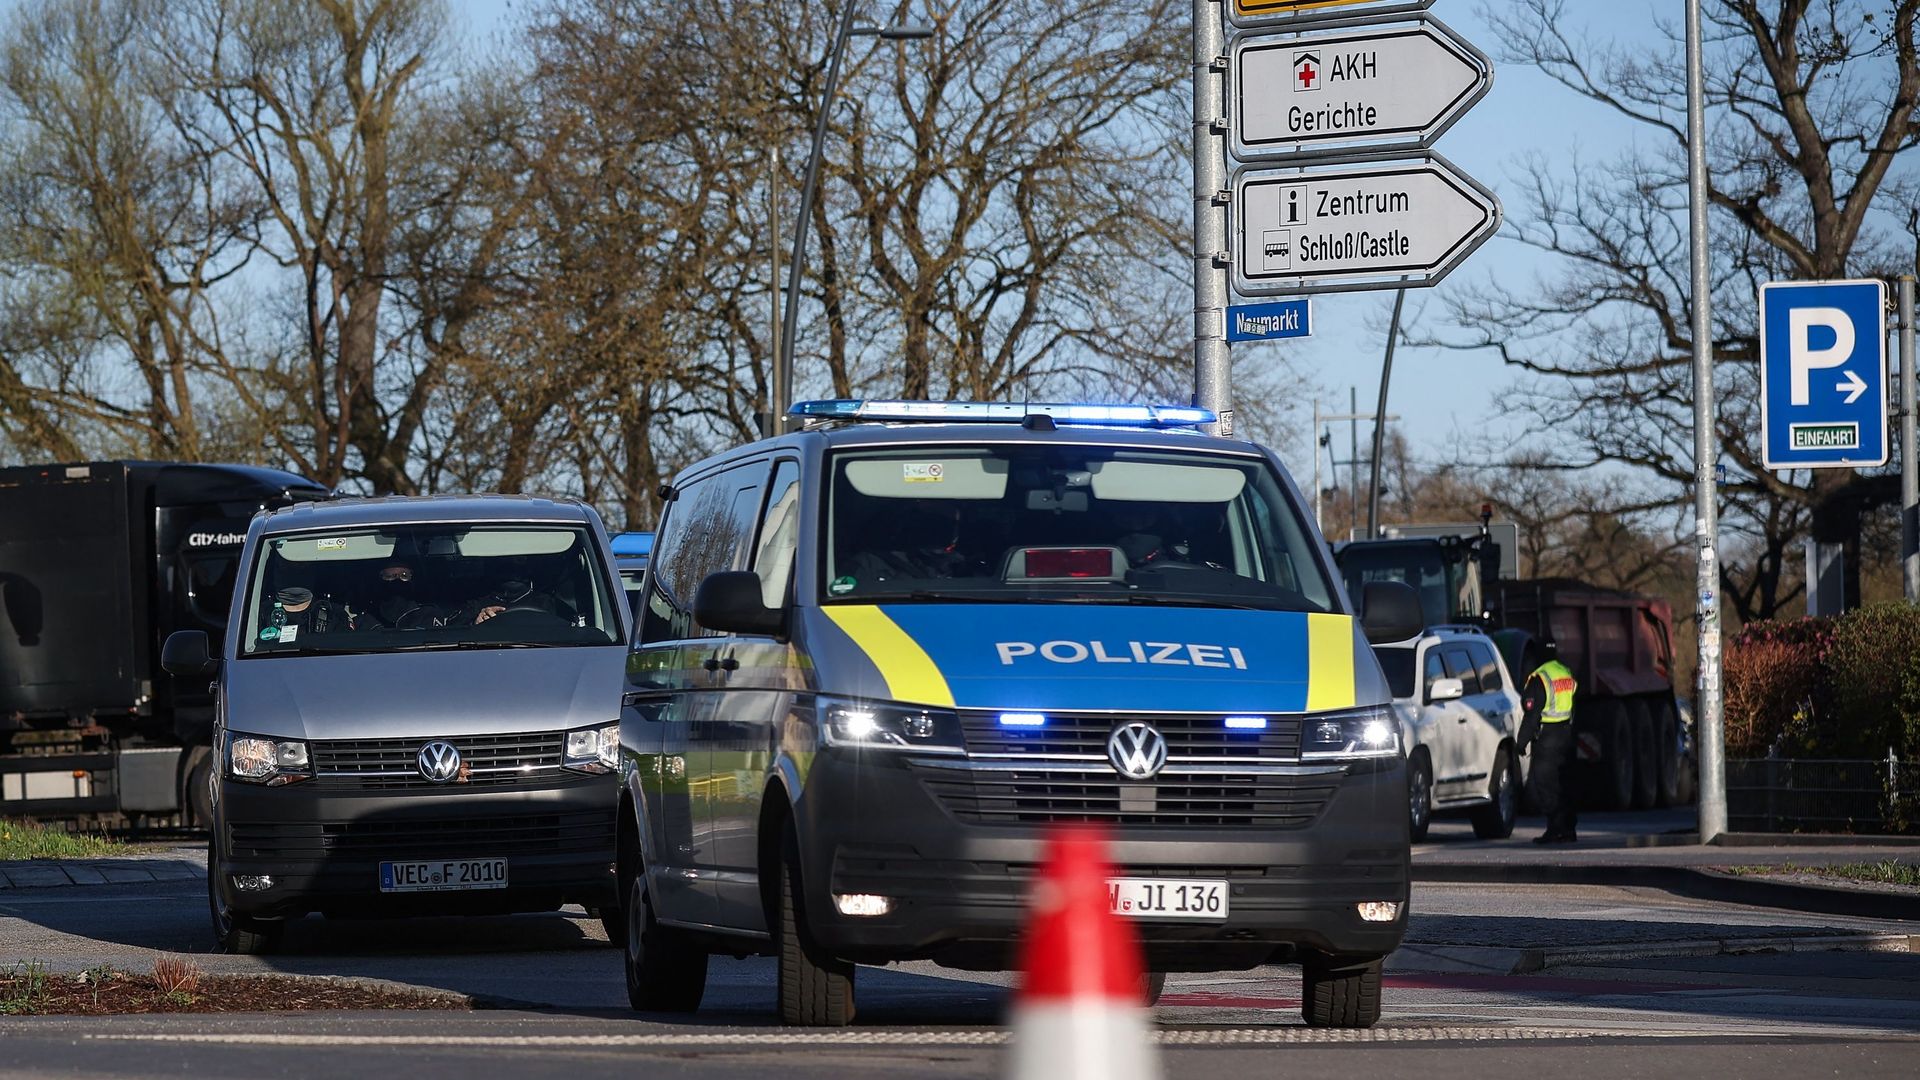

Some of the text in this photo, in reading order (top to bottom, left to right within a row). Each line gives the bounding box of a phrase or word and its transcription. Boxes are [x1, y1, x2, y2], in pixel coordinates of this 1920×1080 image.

[1330, 52, 1377, 82] AKH
[1288, 102, 1377, 132] Gerichte
[1316, 190, 1409, 217] Zentrum
[1299, 229, 1409, 262] Schloß/Castle
[1789, 307, 1856, 406] P
[995, 640, 1248, 670] POLIZEI
[394, 861, 505, 885] VEC F 2010
[1138, 885, 1165, 910] JI
[1175, 886, 1219, 912] 136
